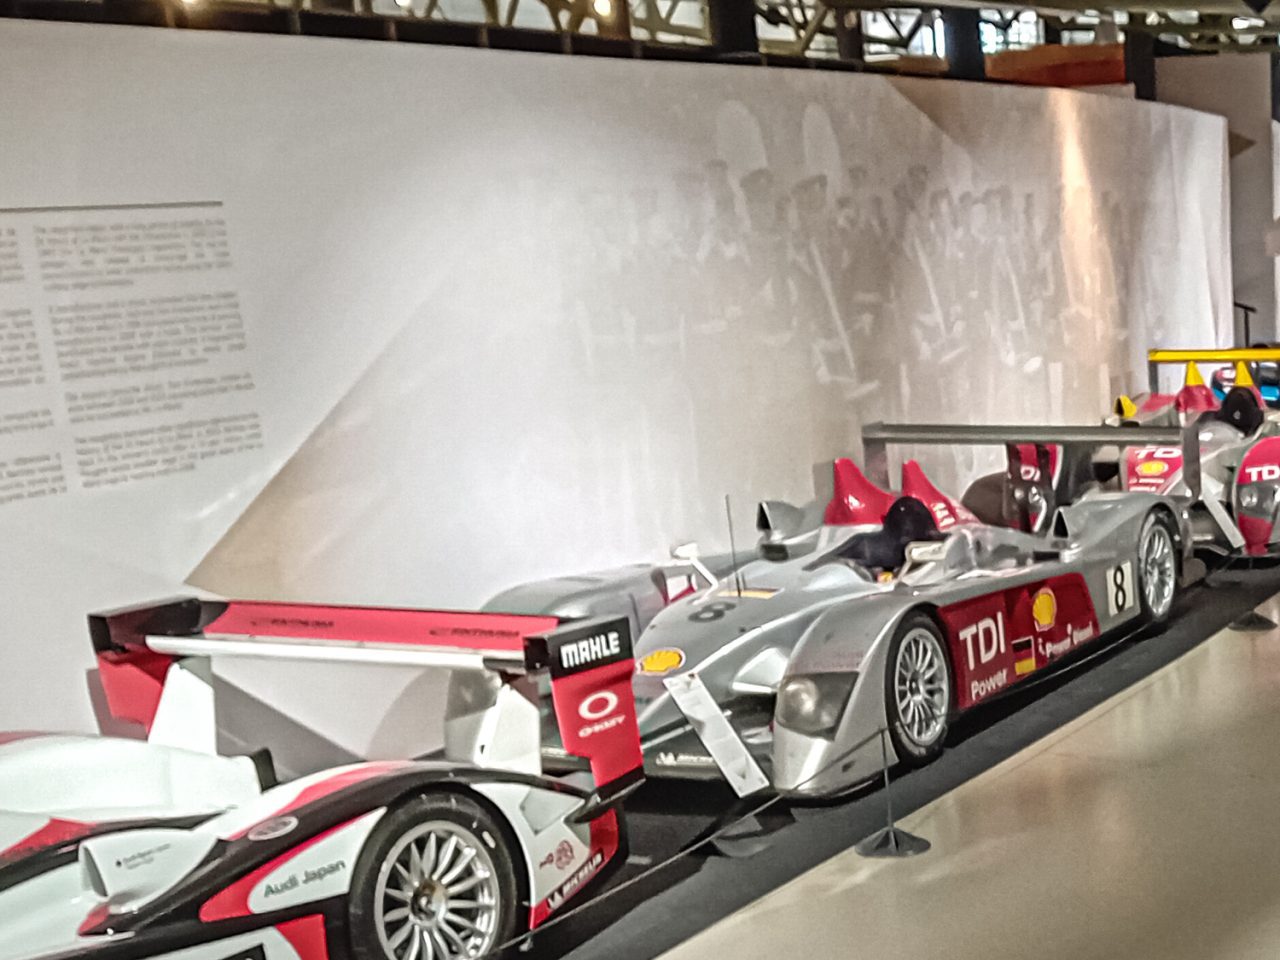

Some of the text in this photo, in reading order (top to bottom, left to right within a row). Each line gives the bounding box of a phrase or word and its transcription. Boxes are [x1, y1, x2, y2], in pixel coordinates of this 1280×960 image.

[1134, 445, 1182, 459] TD
[1113, 565, 1127, 614] 8
[688, 602, 736, 623] 8
[560, 631, 620, 669] MAHLE
[958, 611, 1006, 671] TDI
[971, 669, 1008, 701] Power
[264, 860, 346, 897] Audi Japan
